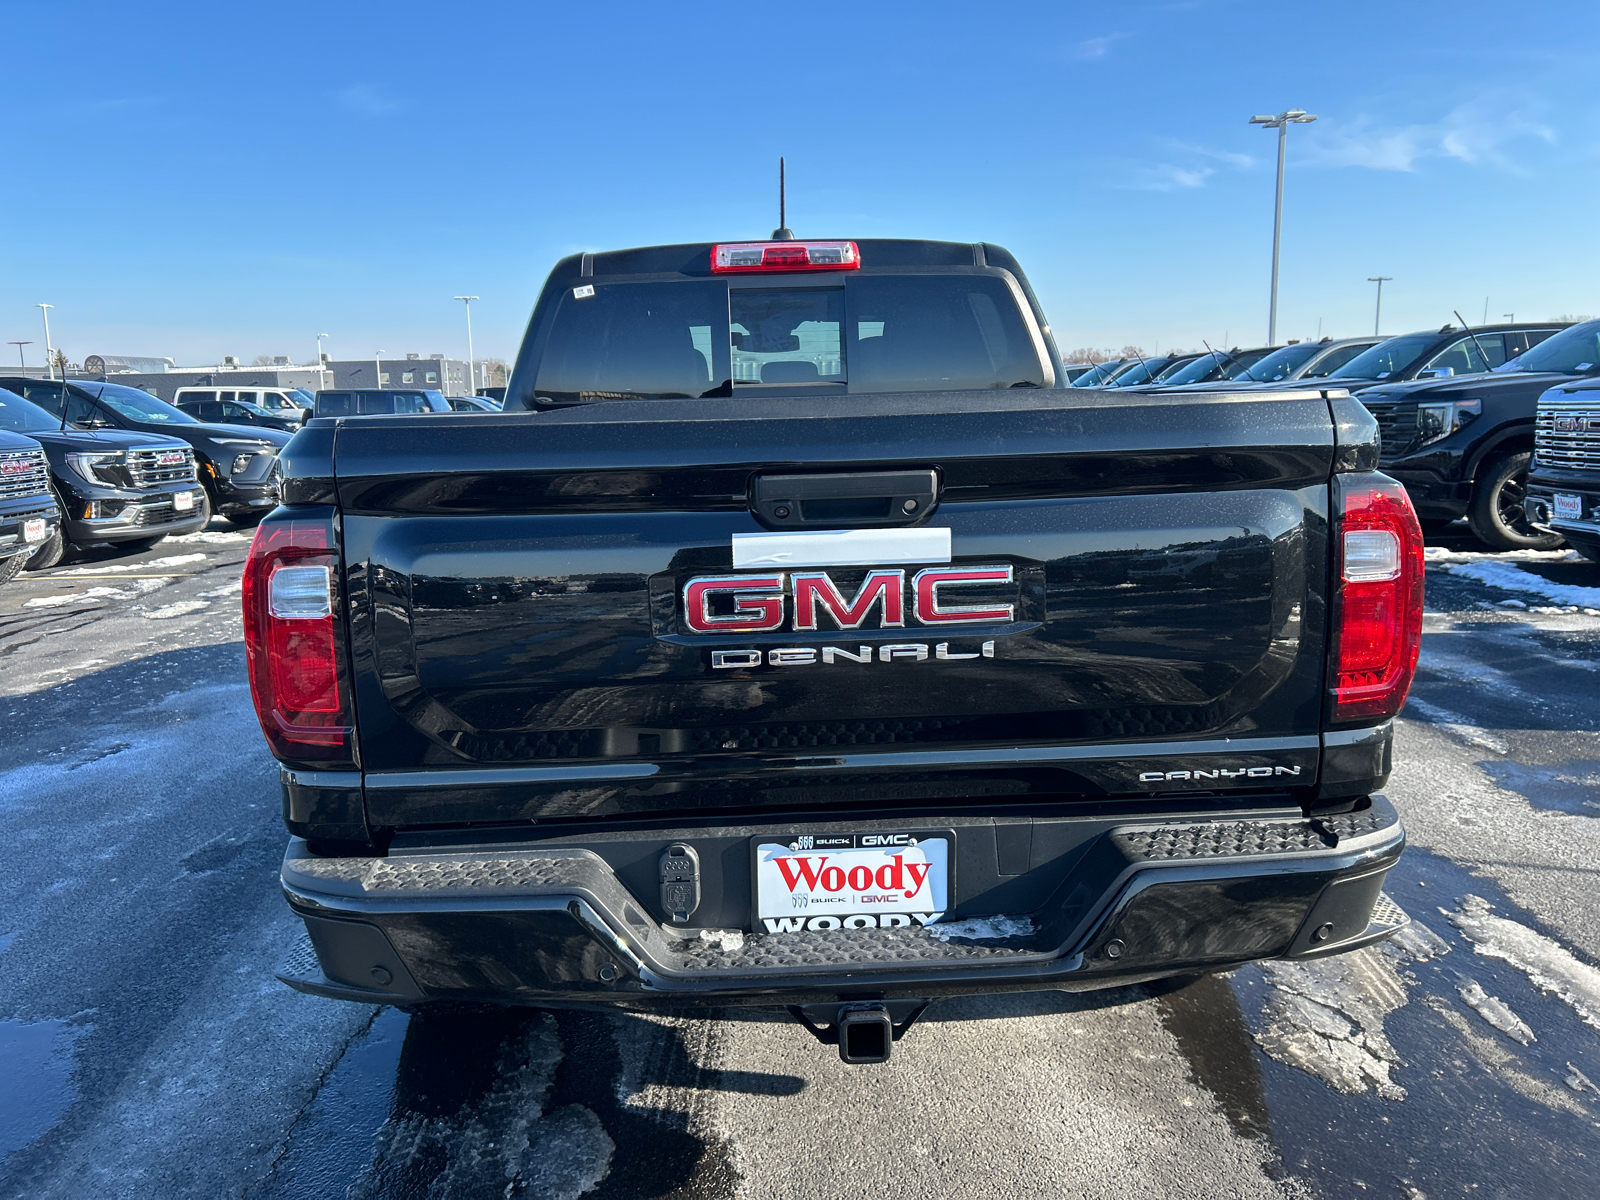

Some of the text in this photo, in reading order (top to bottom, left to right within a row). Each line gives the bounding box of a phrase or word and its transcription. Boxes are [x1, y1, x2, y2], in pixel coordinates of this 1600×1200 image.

[682, 564, 1014, 634] GMC
[711, 640, 995, 669] DENALI
[1139, 765, 1301, 782] CANYON
[862, 834, 909, 846] GMC
[773, 855, 933, 898] Woody
[861, 894, 898, 903] GMC
[763, 912, 945, 934] WOODY
